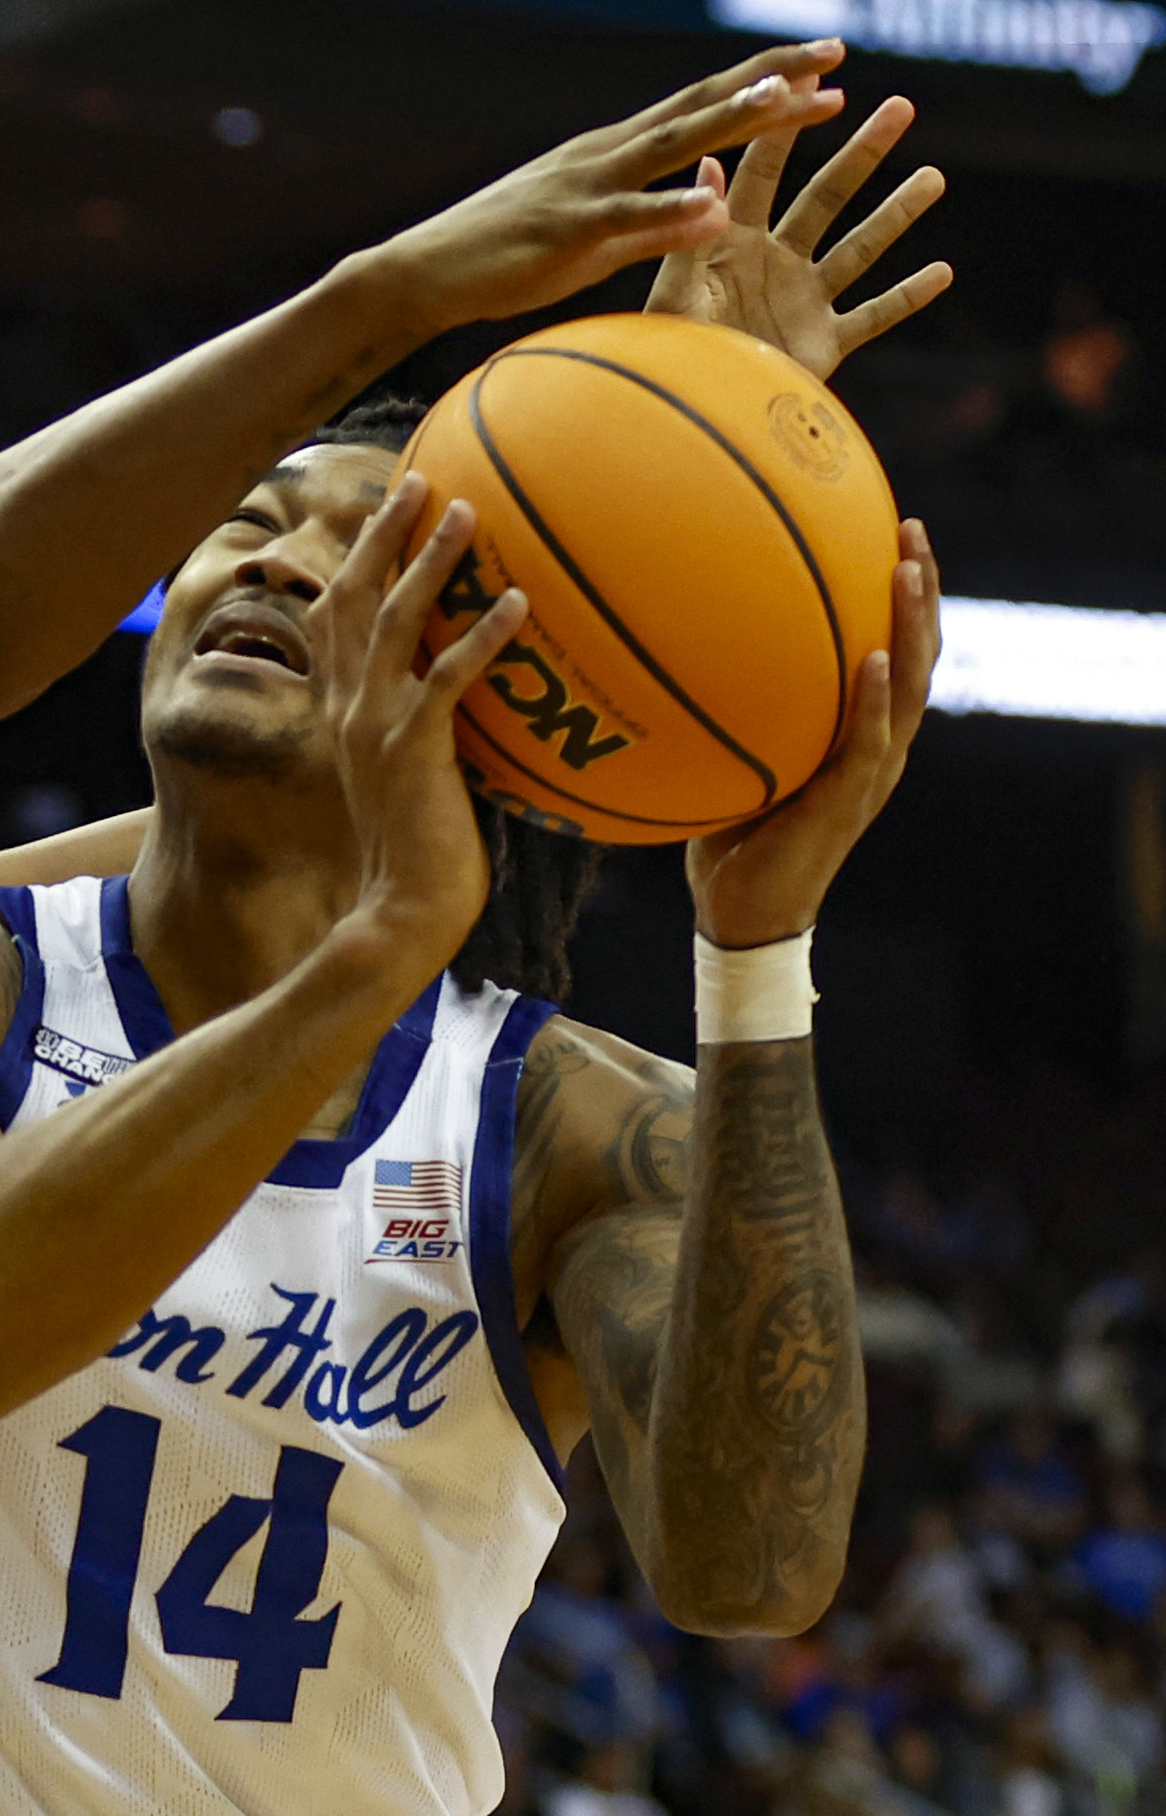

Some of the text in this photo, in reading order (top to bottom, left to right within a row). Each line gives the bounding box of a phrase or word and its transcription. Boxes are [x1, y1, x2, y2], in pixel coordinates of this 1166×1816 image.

[438, 545, 631, 771] NCA
[372, 1240, 465, 1259] EAST
[382, 1219, 450, 1239] BIG
[224, 1281, 479, 1430] Hall
[34, 1403, 346, 1725] 14
